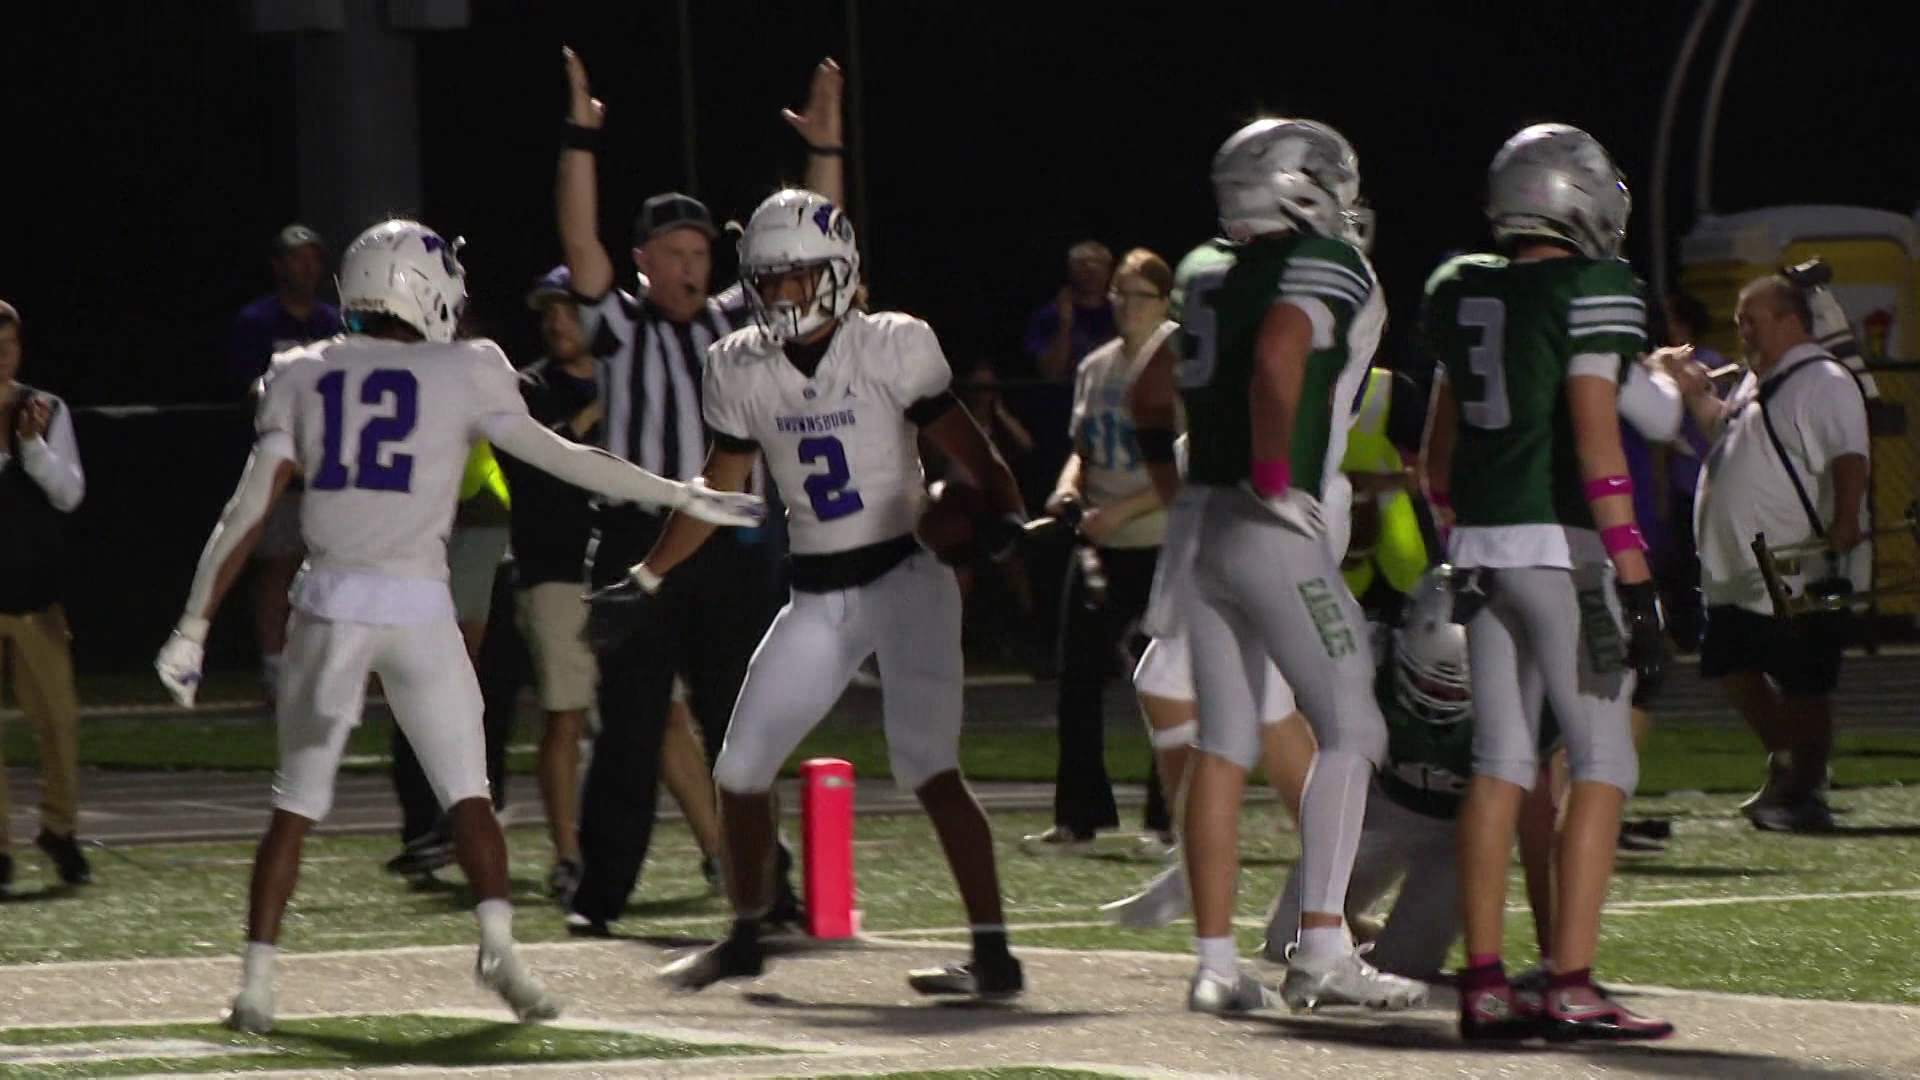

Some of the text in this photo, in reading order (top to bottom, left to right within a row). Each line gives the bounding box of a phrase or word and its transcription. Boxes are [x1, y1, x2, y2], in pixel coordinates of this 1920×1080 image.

[1456, 297, 1512, 430] 3
[311, 368, 418, 493] 12
[798, 435, 864, 522] 2
